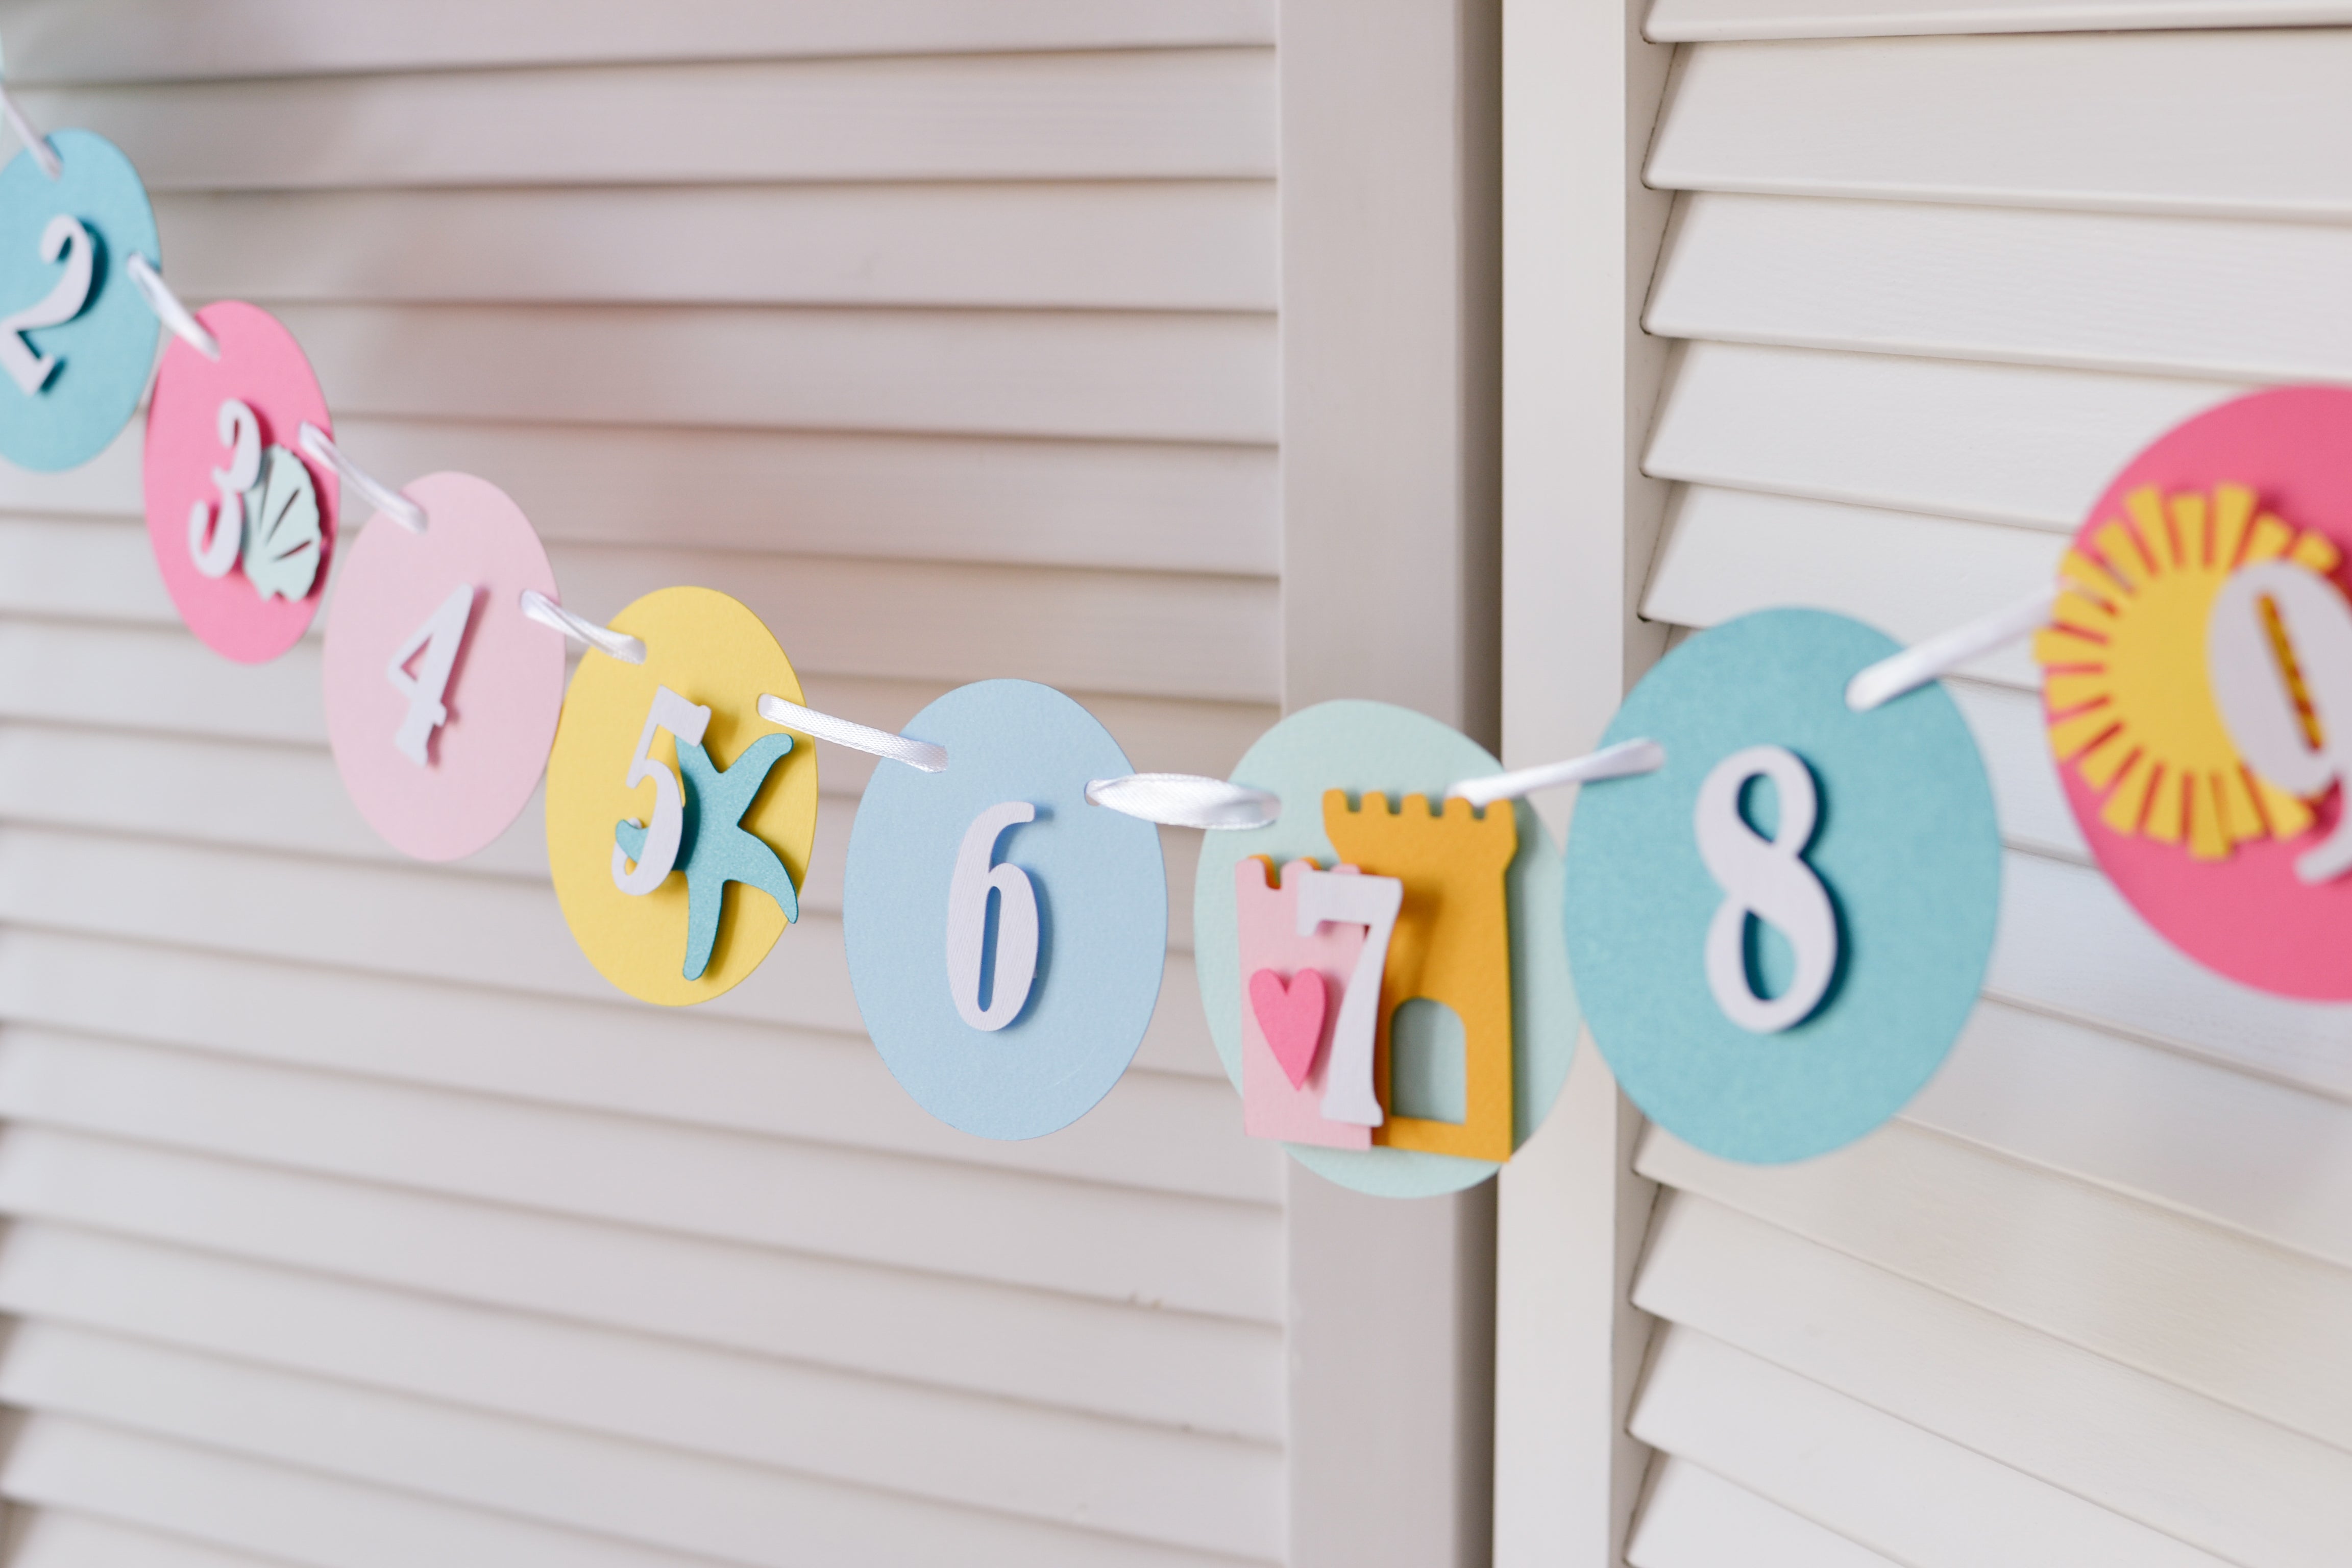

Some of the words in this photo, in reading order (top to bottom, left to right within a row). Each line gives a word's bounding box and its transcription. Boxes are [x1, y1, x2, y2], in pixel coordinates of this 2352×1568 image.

[0, 213, 93, 396] 2
[188, 399, 261, 578] 3
[386, 583, 475, 766] 4
[2207, 558, 2352, 885] 9
[612, 684, 712, 896] 5
[1693, 745, 1837, 1034] 8
[946, 801, 1039, 1032] 6
[1296, 870, 1403, 1127] 7
